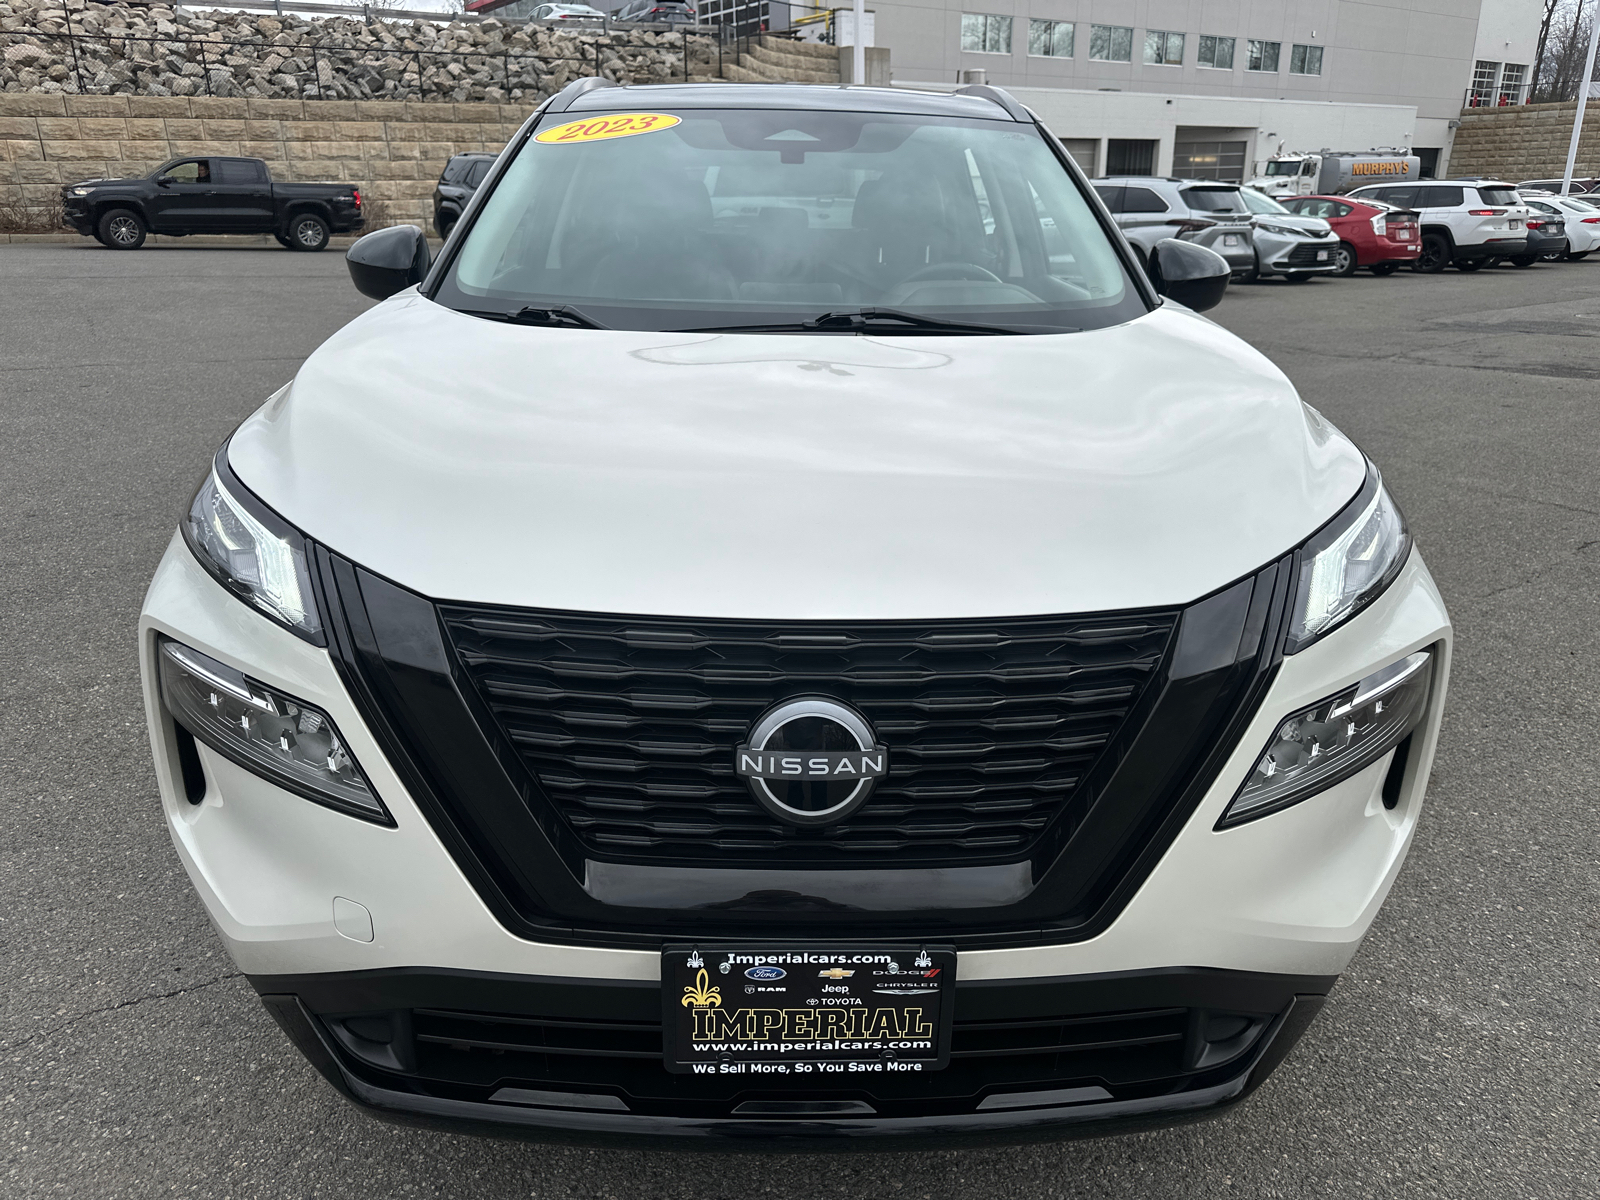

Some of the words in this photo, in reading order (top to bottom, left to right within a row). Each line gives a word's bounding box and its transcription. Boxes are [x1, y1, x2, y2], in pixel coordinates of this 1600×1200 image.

[557, 116, 659, 141] 2023
[1352, 160, 1409, 176] MURPHY'S
[741, 754, 882, 775] NISSAN
[727, 953, 892, 966] Imperialcars.com
[753, 969, 777, 978] Ford
[821, 984, 849, 994] Jeep
[692, 1008, 933, 1040] IMPERIAL
[692, 1040, 932, 1053] www.imperialcars.com
[692, 1064, 716, 1074] We
[719, 1063, 746, 1074] Sell
[750, 1063, 791, 1075] More,
[794, 1063, 814, 1073] So
[817, 1062, 844, 1073] You
[848, 1062, 883, 1072] Save
[886, 1061, 922, 1072] More
